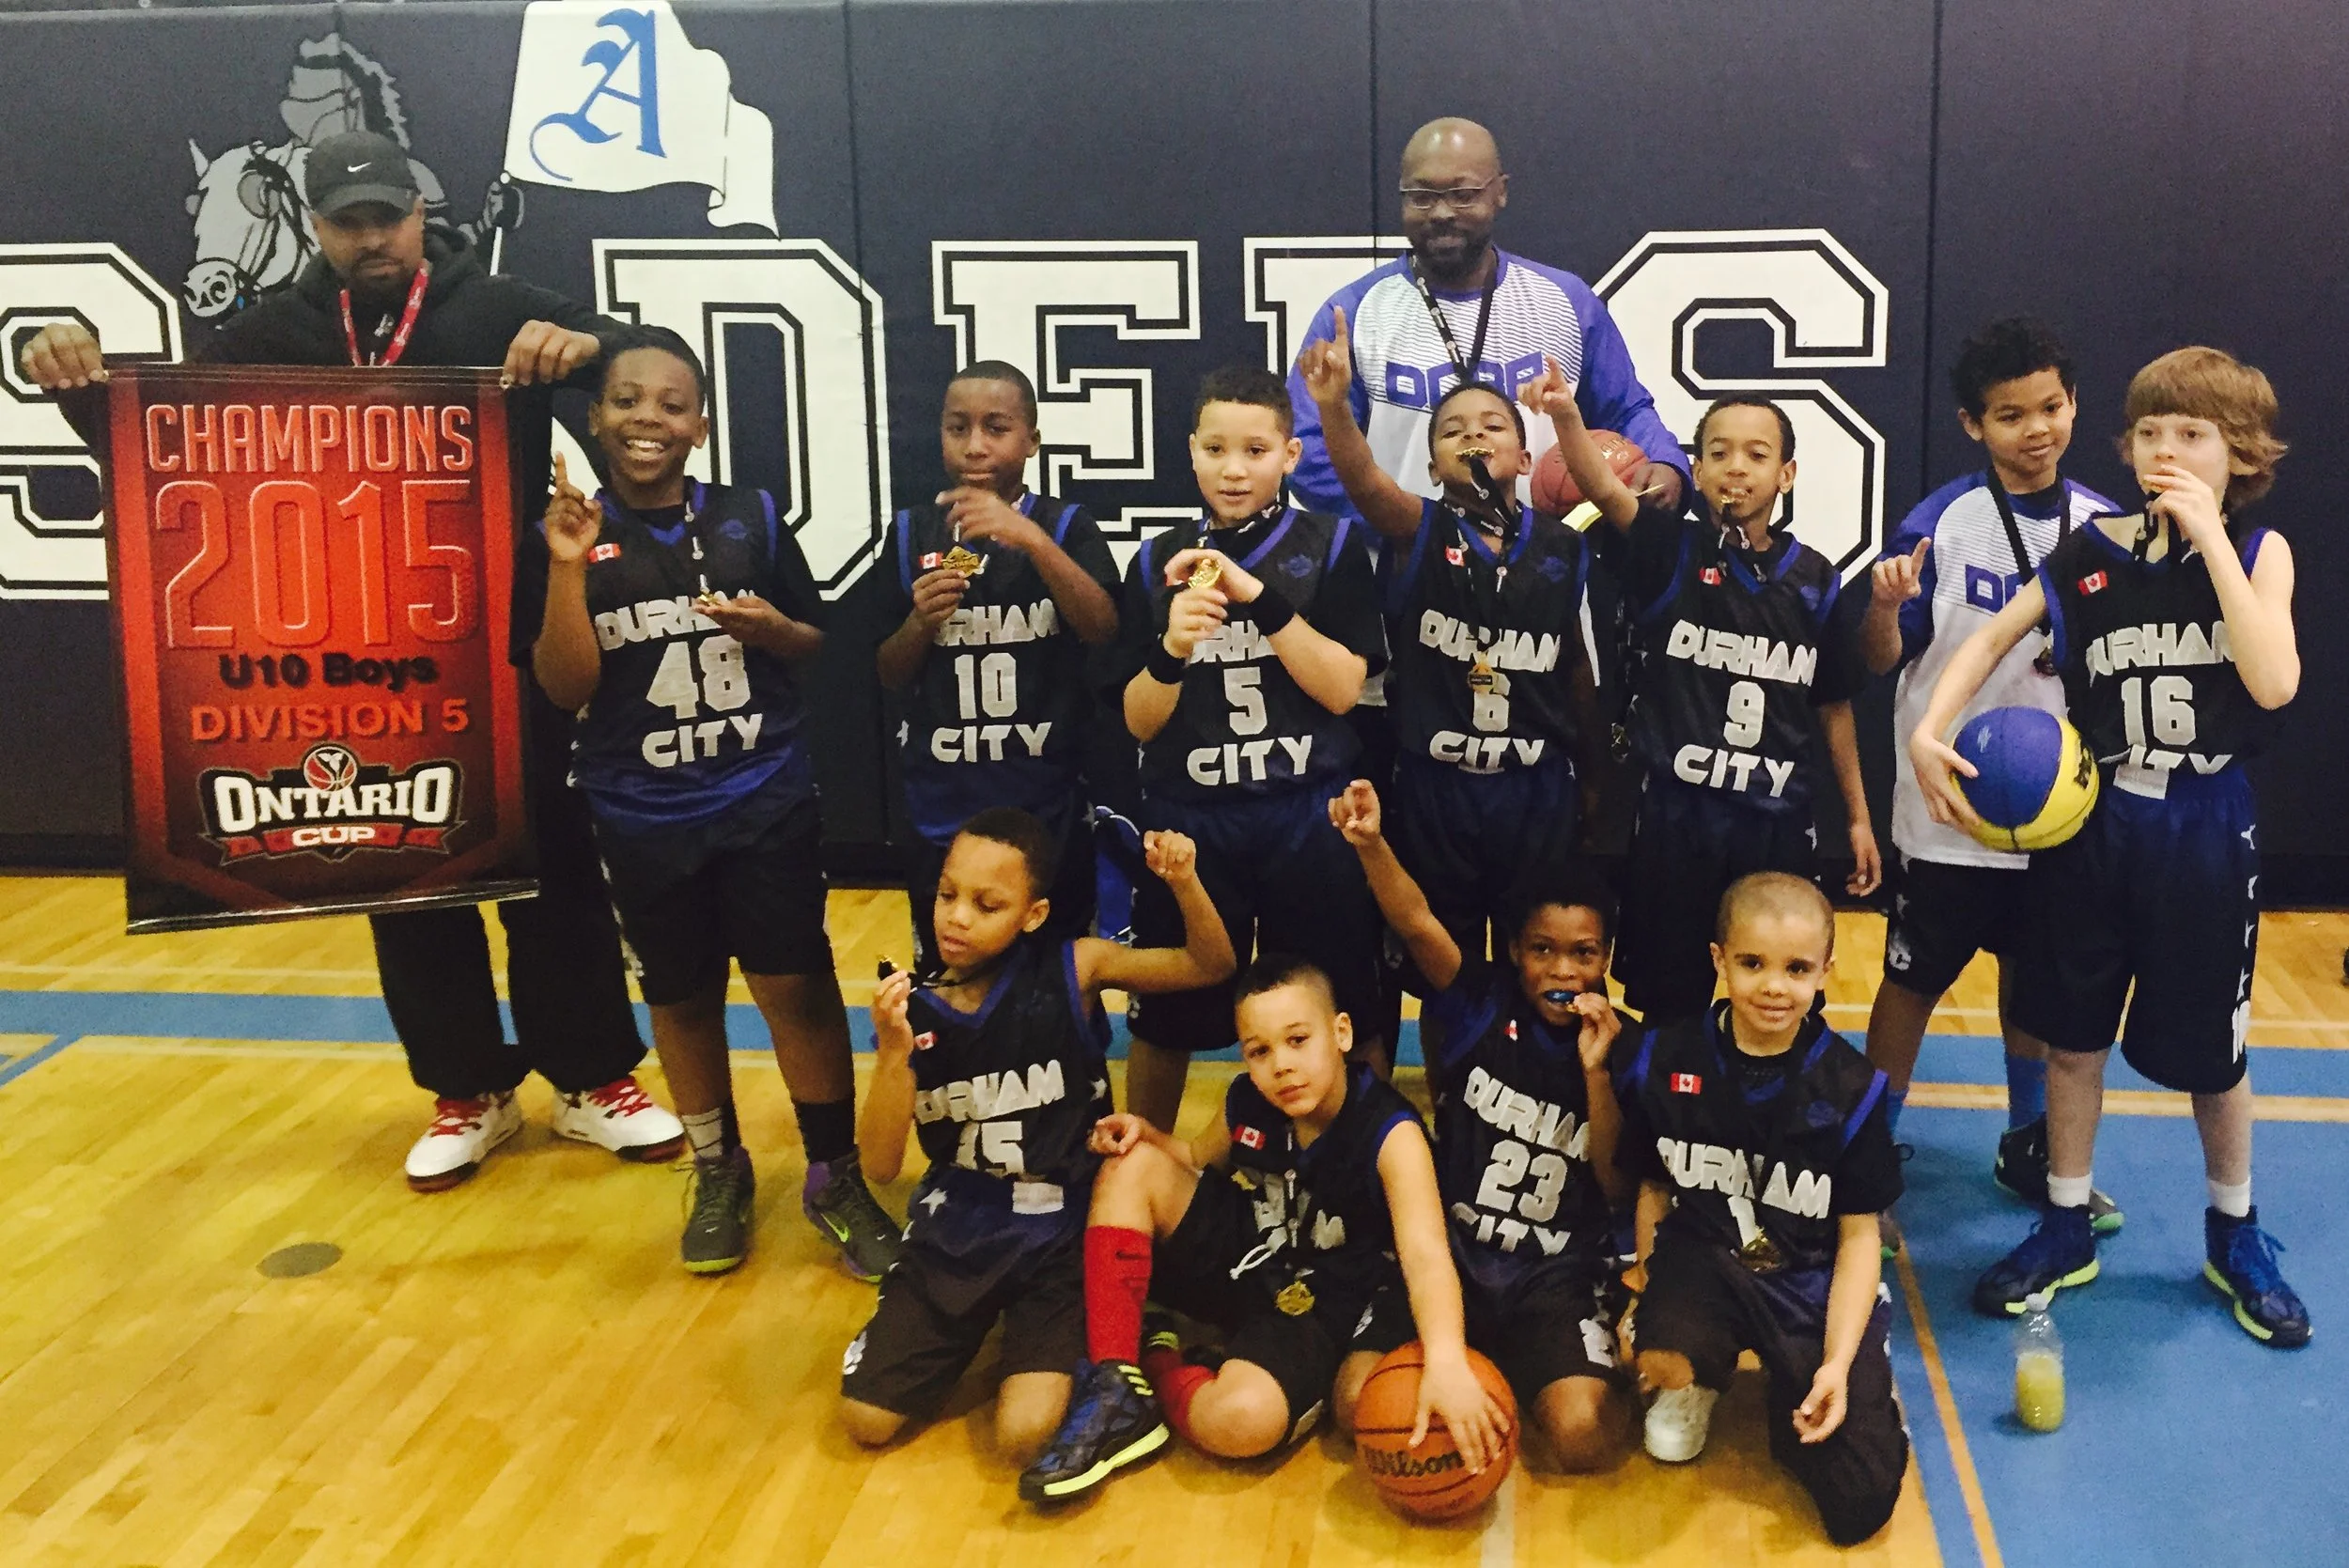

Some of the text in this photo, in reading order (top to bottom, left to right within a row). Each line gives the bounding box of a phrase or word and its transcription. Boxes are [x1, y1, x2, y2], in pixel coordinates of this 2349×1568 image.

[529, 8, 668, 181] A
[146, 404, 474, 473] CHAMPIONS
[155, 479, 481, 649] 2015
[595, 588, 755, 651] DURH
[934, 598, 1060, 647] RHAM
[219, 652, 441, 693] U10 Boys
[646, 634, 752, 720] 48
[1666, 618, 1818, 688] DURHAM
[2086, 620, 2235, 689] URHAM
[955, 652, 1018, 721] 10
[1223, 666, 1268, 737] 5
[1472, 671, 1512, 733] 6
[1723, 680, 1766, 749] 9
[2121, 675, 2197, 746] 16
[191, 698, 470, 741] DIVISION 5
[642, 712, 763, 768] CITY
[931, 722, 1052, 763] CITY
[1429, 730, 1546, 768] CITY
[1187, 735, 1313, 786] CITY
[1673, 744, 1795, 798] CITY
[213, 767, 453, 833] ONTARIO
[291, 826, 376, 846] CUP
[954, 1120, 1025, 1178] 15
[1475, 1140, 1568, 1223] 23
[1362, 1443, 1466, 1478] Wilson
